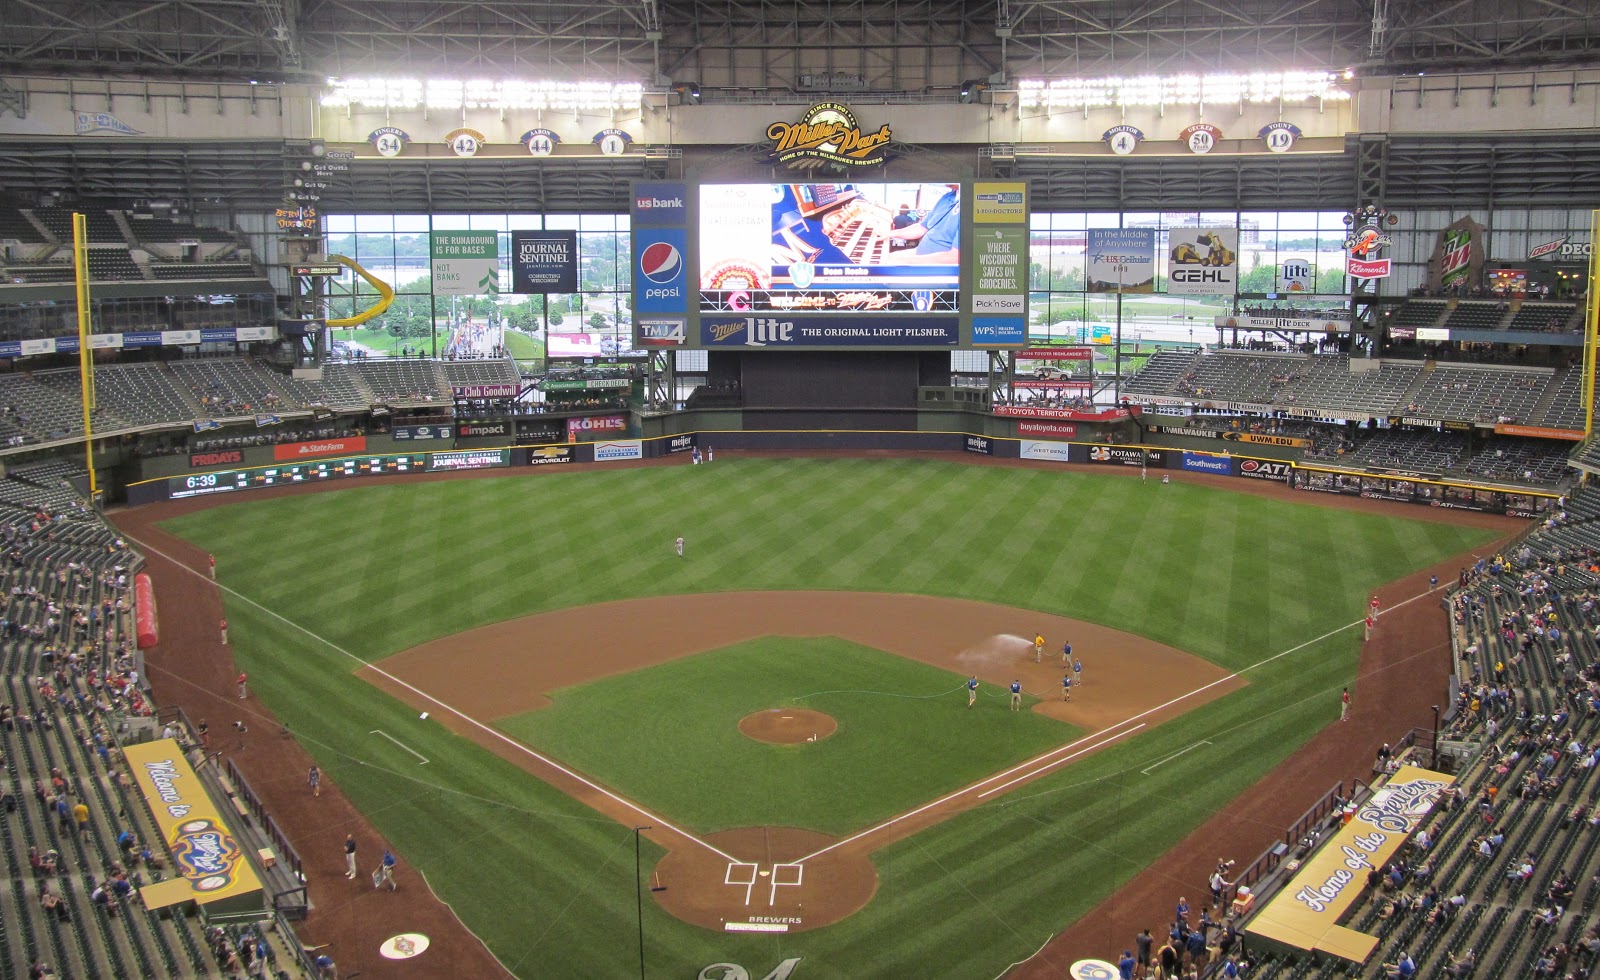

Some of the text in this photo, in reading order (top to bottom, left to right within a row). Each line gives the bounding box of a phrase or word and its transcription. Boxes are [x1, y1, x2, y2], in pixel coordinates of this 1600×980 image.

[809, 103, 848, 115] SINCE 2001
[374, 128, 403, 136] FINGERS
[1109, 126, 1138, 135] MOLITOR
[767, 120, 892, 157] Miller Park
[1117, 137, 1127, 150] 4
[1193, 133, 1209, 145] 50
[1270, 133, 1289, 148] 19
[380, 138, 399, 152] 34
[456, 139, 475, 153] 42
[531, 139, 550, 153] 44
[609, 140, 617, 153] 1
[326, 151, 355, 159] Gone!
[779, 152, 796, 162] HOME
[819, 152, 853, 165] MILWAUKEE
[855, 156, 883, 165] BREWERS
[435, 236, 495, 245] THE RUNAROUND
[1105, 239, 1147, 248] Anywhere
[436, 246, 485, 254] IS FOR BASES
[520, 245, 569, 254] JOURNAL
[987, 242, 1010, 253] WHERE
[519, 254, 569, 264] SENTINEL
[979, 254, 1018, 265] WISCONSIN
[1120, 255, 1151, 263] Cellular
[436, 264, 450, 272] NOT
[982, 267, 1014, 278] SAVES ON
[1283, 264, 1308, 280] Lite
[1349, 263, 1387, 274] Klement's
[436, 273, 460, 281] BANKS
[1171, 270, 1231, 283] GEHL
[979, 279, 1018, 289] GROCERIES.
[769, 296, 826, 307] WELCOME
[975, 300, 992, 308] Pick
[1000, 300, 1021, 308] Save
[709, 317, 948, 346] Miller Lite THE ORIGINAL LIGHT PILSNER.
[974, 327, 995, 335] WPS
[464, 386, 517, 398] Club Goodwill
[1008, 408, 1073, 418] TOYOTA TERRITORY
[1303, 408, 1320, 416] WTMJ
[569, 416, 625, 430] KOHL'S
[1020, 422, 1073, 433] buyatoyota.com
[1402, 418, 1442, 428] CATERPILLAR
[468, 425, 504, 436] impact
[671, 435, 692, 447] meijer
[967, 437, 987, 449] meijer
[1250, 435, 1293, 445] UWM.EDU
[191, 451, 242, 466] FRIDAYS
[1090, 446, 1160, 461] 25 POTAWAMI
[432, 456, 502, 468] JOURNAL SENTINEL
[531, 457, 571, 465] CHEVROLET
[1186, 458, 1222, 469] Southwest
[1254, 463, 1291, 475] ATI
[1241, 471, 1264, 479] PHYSICAL
[187, 475, 216, 488] 6:39
[1370, 493, 1382, 501] ATI
[1440, 502, 1453, 510] ATI
[1516, 510, 1529, 518] ATI
[144, 759, 192, 819] Welcome to
[1356, 779, 1448, 834] Brewers
[1295, 831, 1388, 913] Home of the
[748, 916, 802, 924] BREWERS
